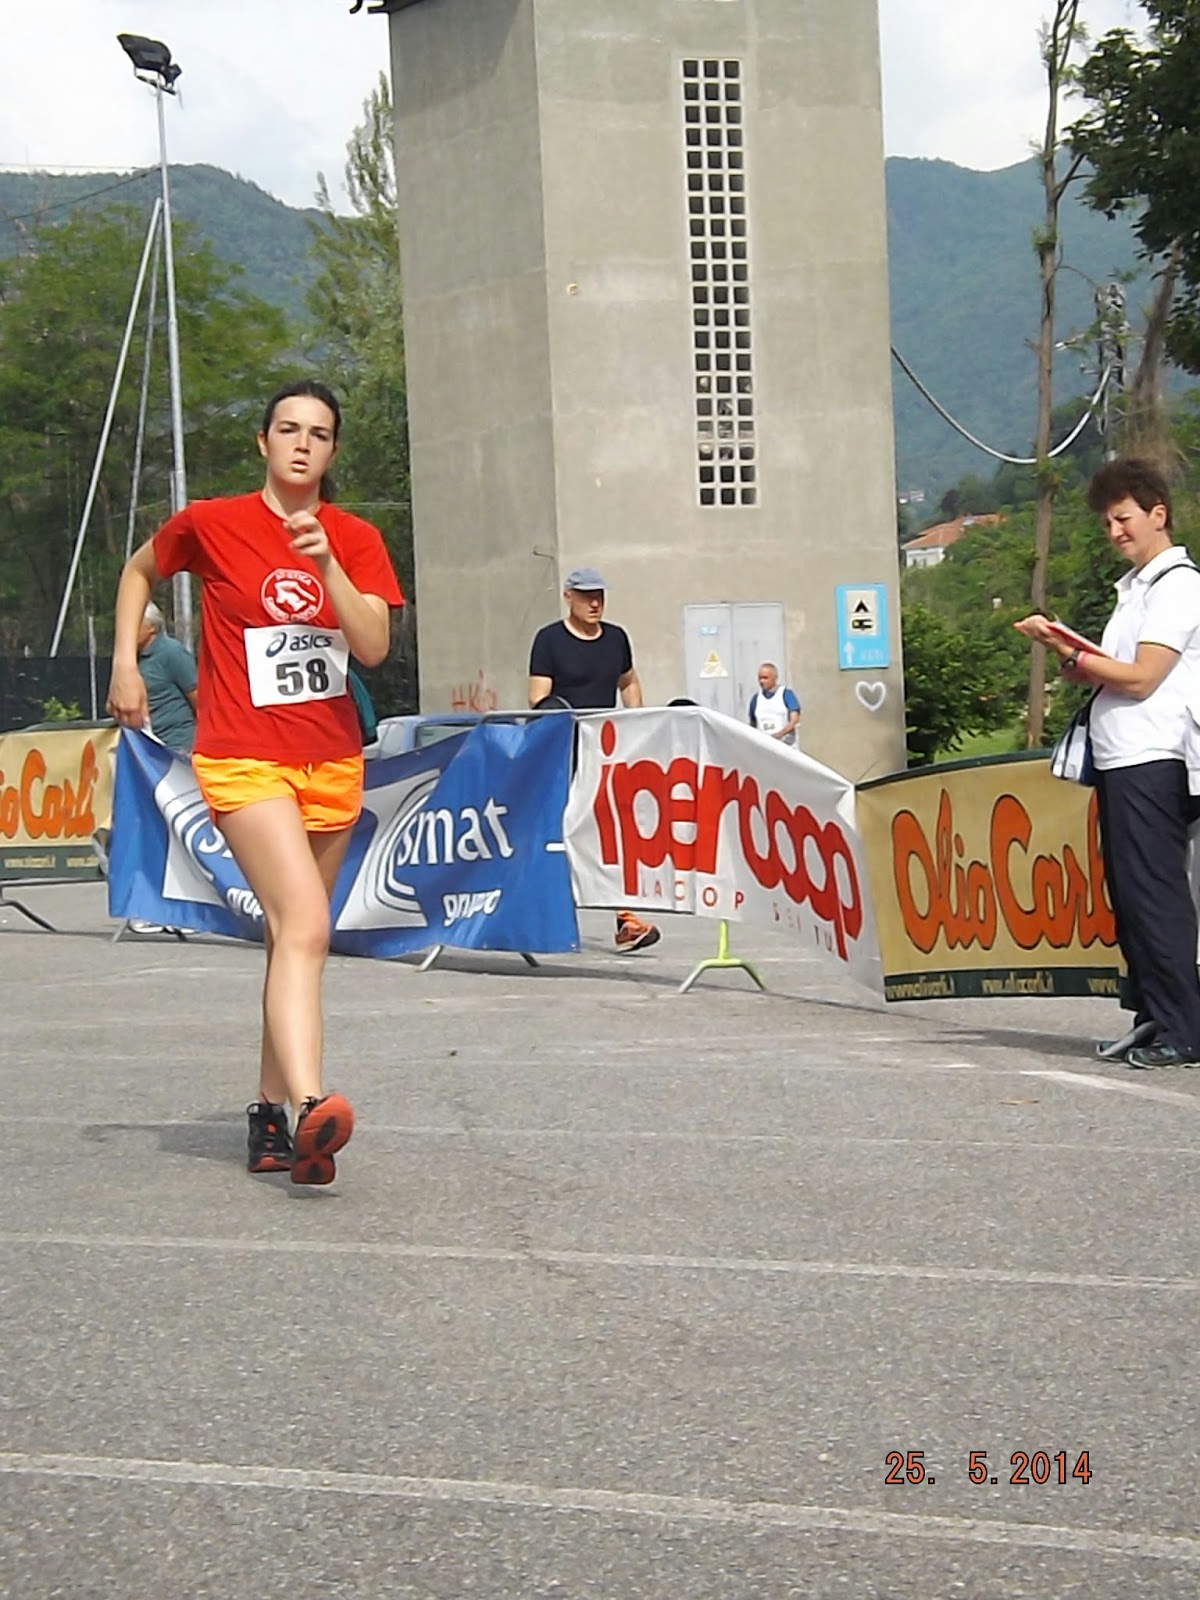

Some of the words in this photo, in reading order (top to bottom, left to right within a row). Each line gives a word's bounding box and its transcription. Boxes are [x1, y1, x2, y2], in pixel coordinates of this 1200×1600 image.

[289, 633, 334, 651] asics
[275, 658, 329, 696] 58
[396, 797, 514, 866] smat
[593, 719, 863, 962] ipercoop
[892, 788, 998, 954] Olio
[991, 793, 1118, 949] Carl
